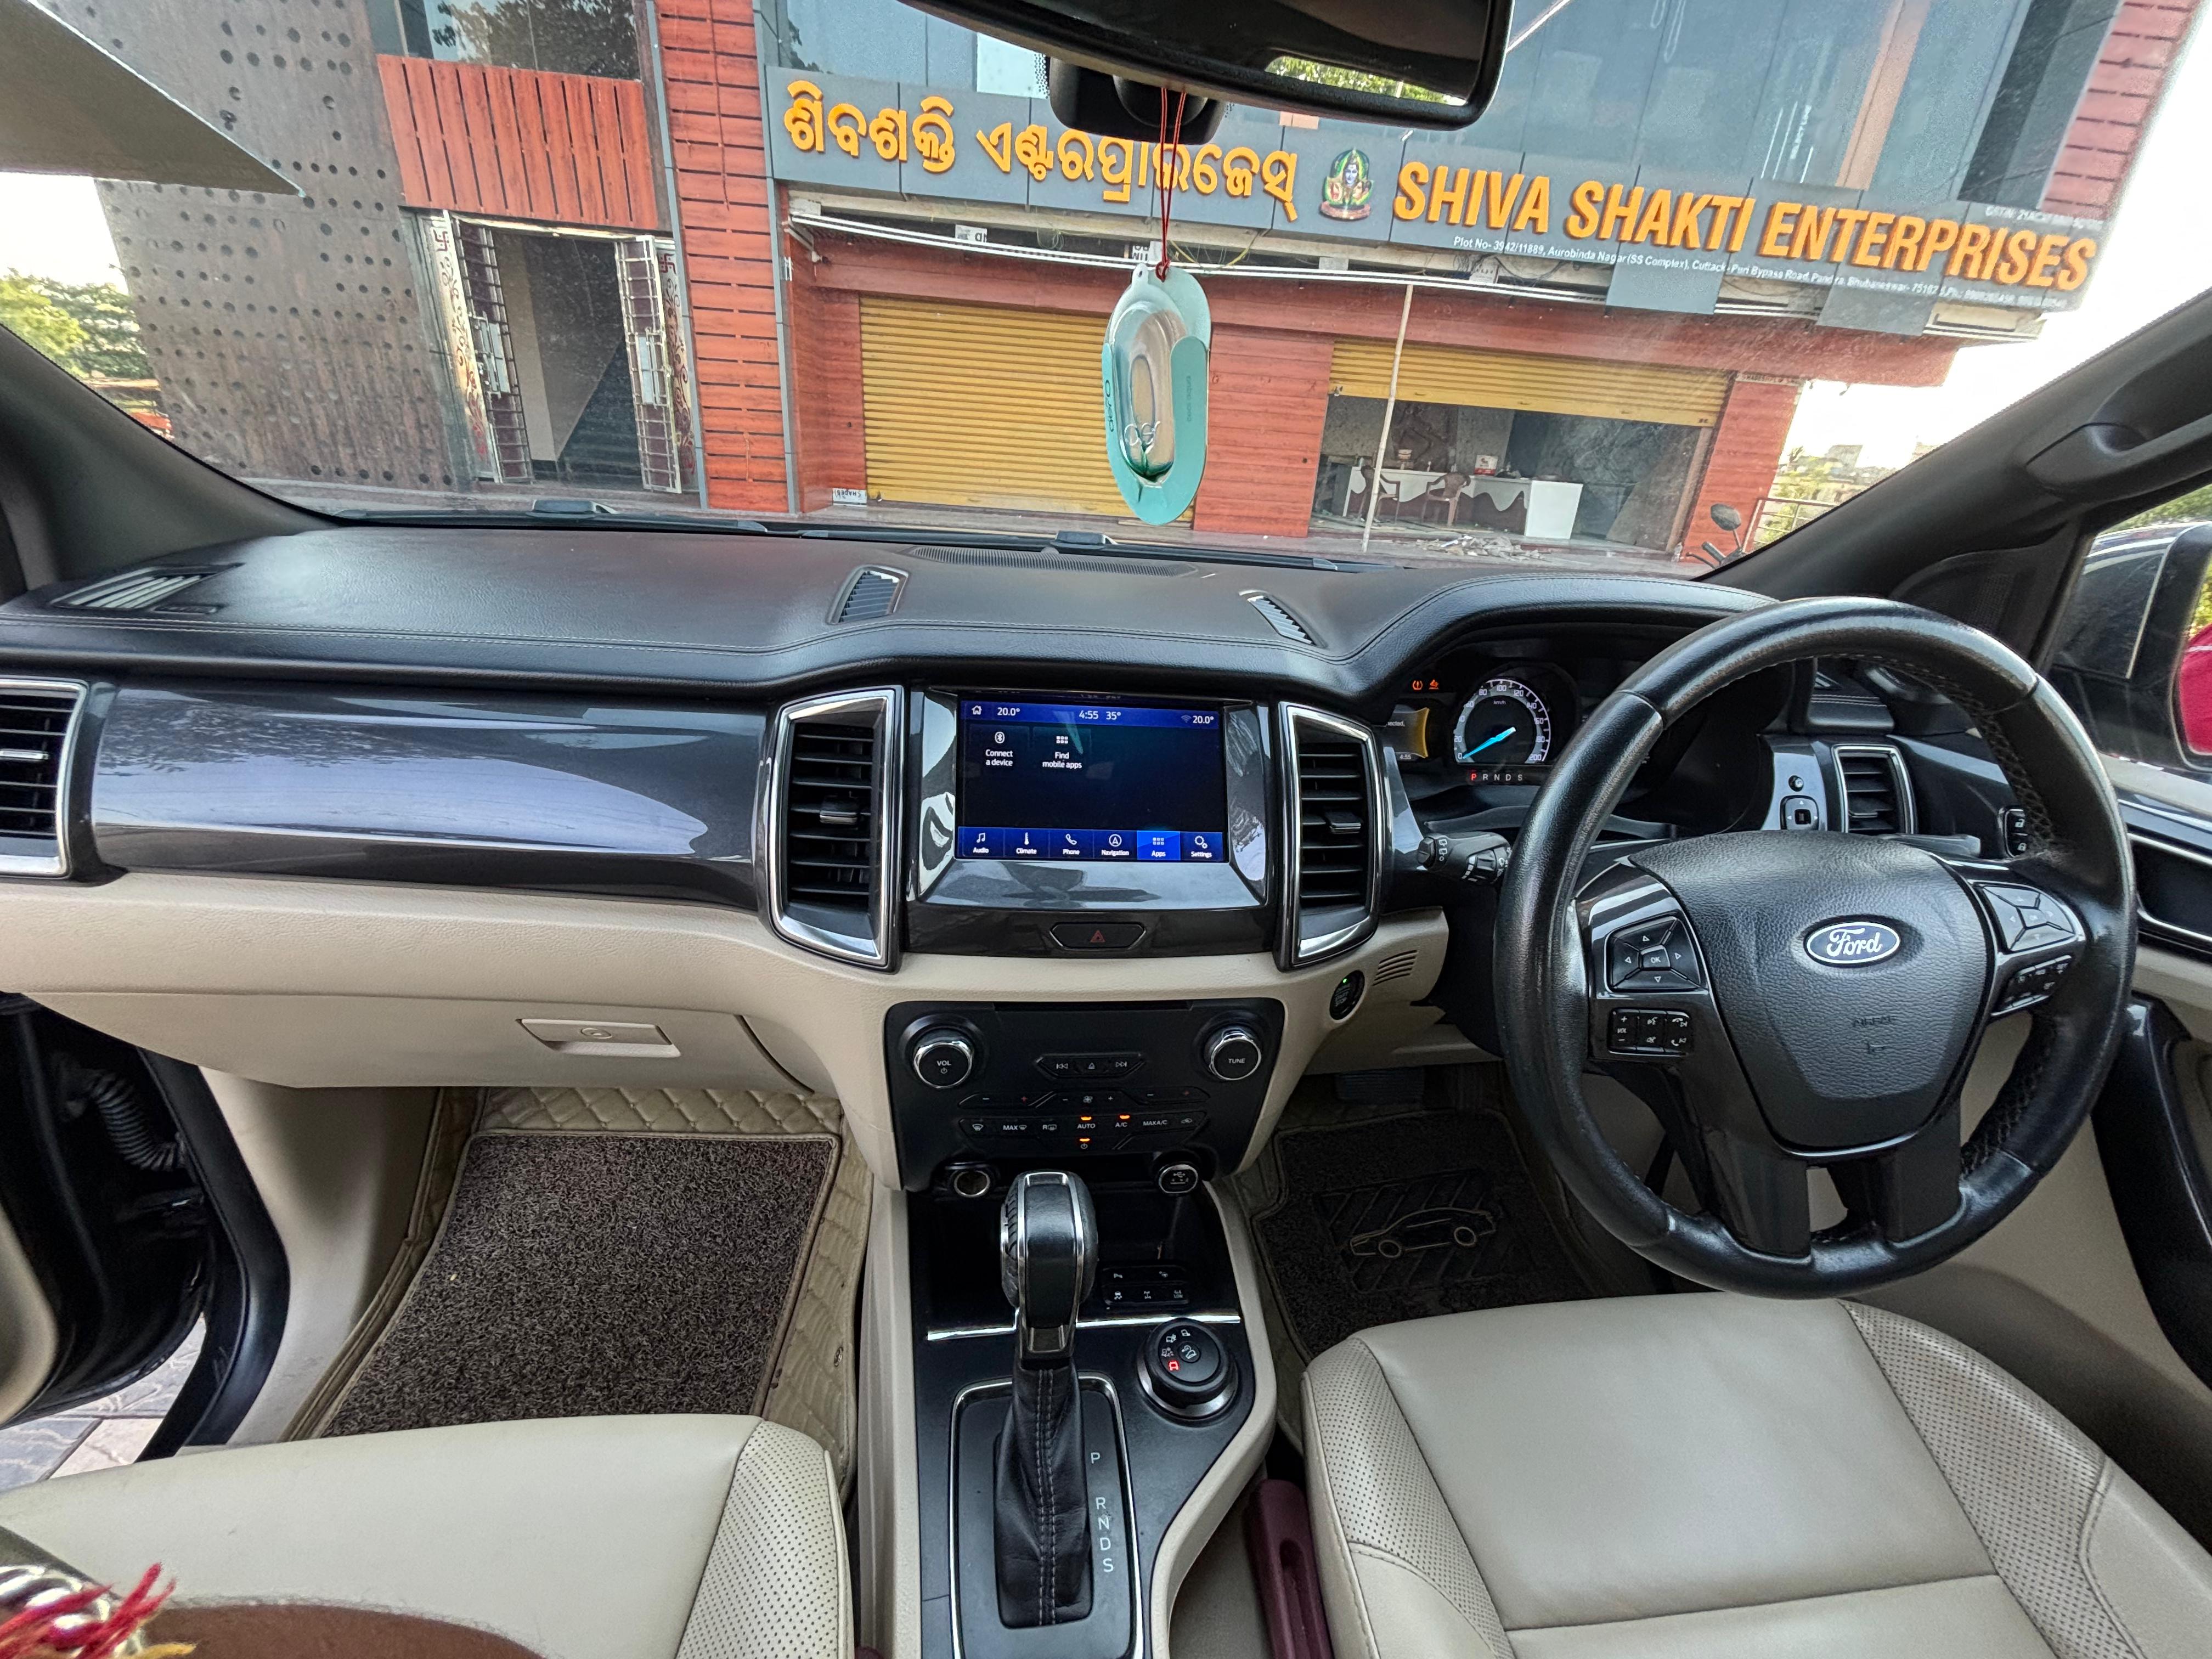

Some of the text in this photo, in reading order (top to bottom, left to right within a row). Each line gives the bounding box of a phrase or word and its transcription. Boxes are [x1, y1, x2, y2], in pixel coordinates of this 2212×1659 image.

[784, 80, 956, 173] ଶିବଶକ୍ତି
[1393, 161, 2097, 291] SHIVA SHAKTI ENTERPRISES
[1454, 236, 1472, 247] Plot
[1548, 246, 1595, 259] Aurobinda
[1750, 266, 1783, 279] Bypass
[997, 707, 1020, 716] 20.0°
[1079, 710, 1121, 720] 4:55 35°
[1193, 715, 1214, 724] 20.0°
[986, 749, 1013, 758] Connect
[991, 758, 1013, 766] device
[1042, 760, 1065, 769] mobile
[1826, 928, 1882, 957] Ford
[1090, 1452, 1101, 1464] P
[1096, 1497, 1106, 1510] R
[1098, 1516, 1110, 1530] N
[1099, 1537, 1111, 1551] D
[1103, 1558, 1114, 1572] S
